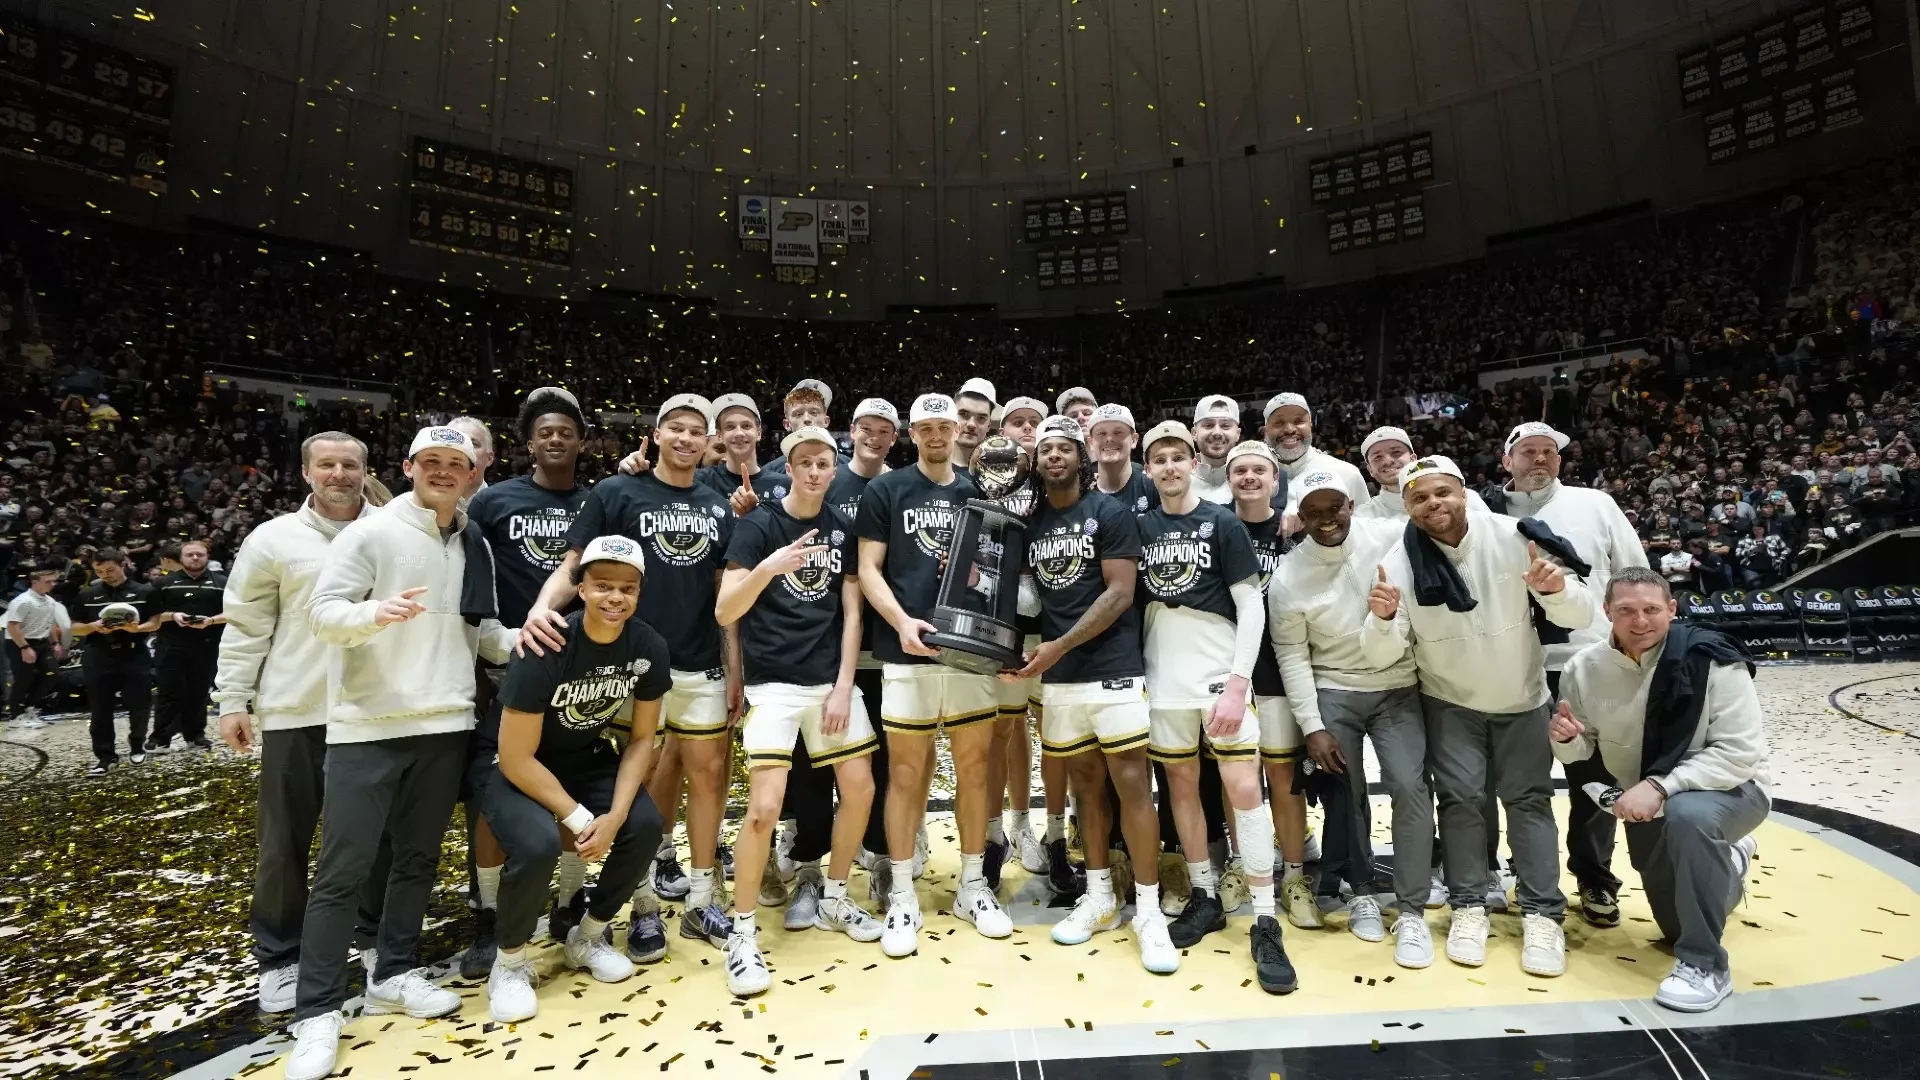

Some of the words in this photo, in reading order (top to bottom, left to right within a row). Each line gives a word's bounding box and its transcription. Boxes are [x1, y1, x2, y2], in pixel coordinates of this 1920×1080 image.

[59, 49, 79, 70] 7
[93, 61, 129, 88] 23
[137, 76, 170, 99] 37
[45, 120, 84, 145] 43
[89, 133, 127, 158] 42
[417, 152, 436, 169] 10
[443, 156, 467, 176] 22
[471, 163, 494, 184] 23
[553, 181, 569, 197] 13
[417, 209, 430, 227] 4
[440, 214, 465, 232] 25
[742, 216, 767, 225] FINAL
[821, 220, 846, 230] FINAL
[497, 224, 519, 242] 50
[823, 229, 845, 238] FOUR
[774, 250, 815, 258] CHAMPIONS
[777, 243, 811, 251] NATIONAL
[775, 265, 816, 284] 1932
[509, 514, 572, 540] CHAMPI
[640, 511, 719, 542] CHAMPIONS
[903, 508, 955, 535] CHAMPI
[518, 544, 541, 568] PURDUE
[1028, 534, 1095, 568] CHAMPIONS
[1137, 541, 1212, 571] CHAMPIONS
[801, 548, 842, 574] PIONS
[1689, 605, 1715, 614] GEMCO
[1721, 604, 1746, 612] GEMCO
[1752, 602, 1784, 611] GEMCO
[1806, 601, 1841, 611] GEMCO
[1856, 599, 1882, 607] GEMCO
[1884, 598, 1912, 606] GEMCO
[550, 675, 639, 707] CHAMPIONS
